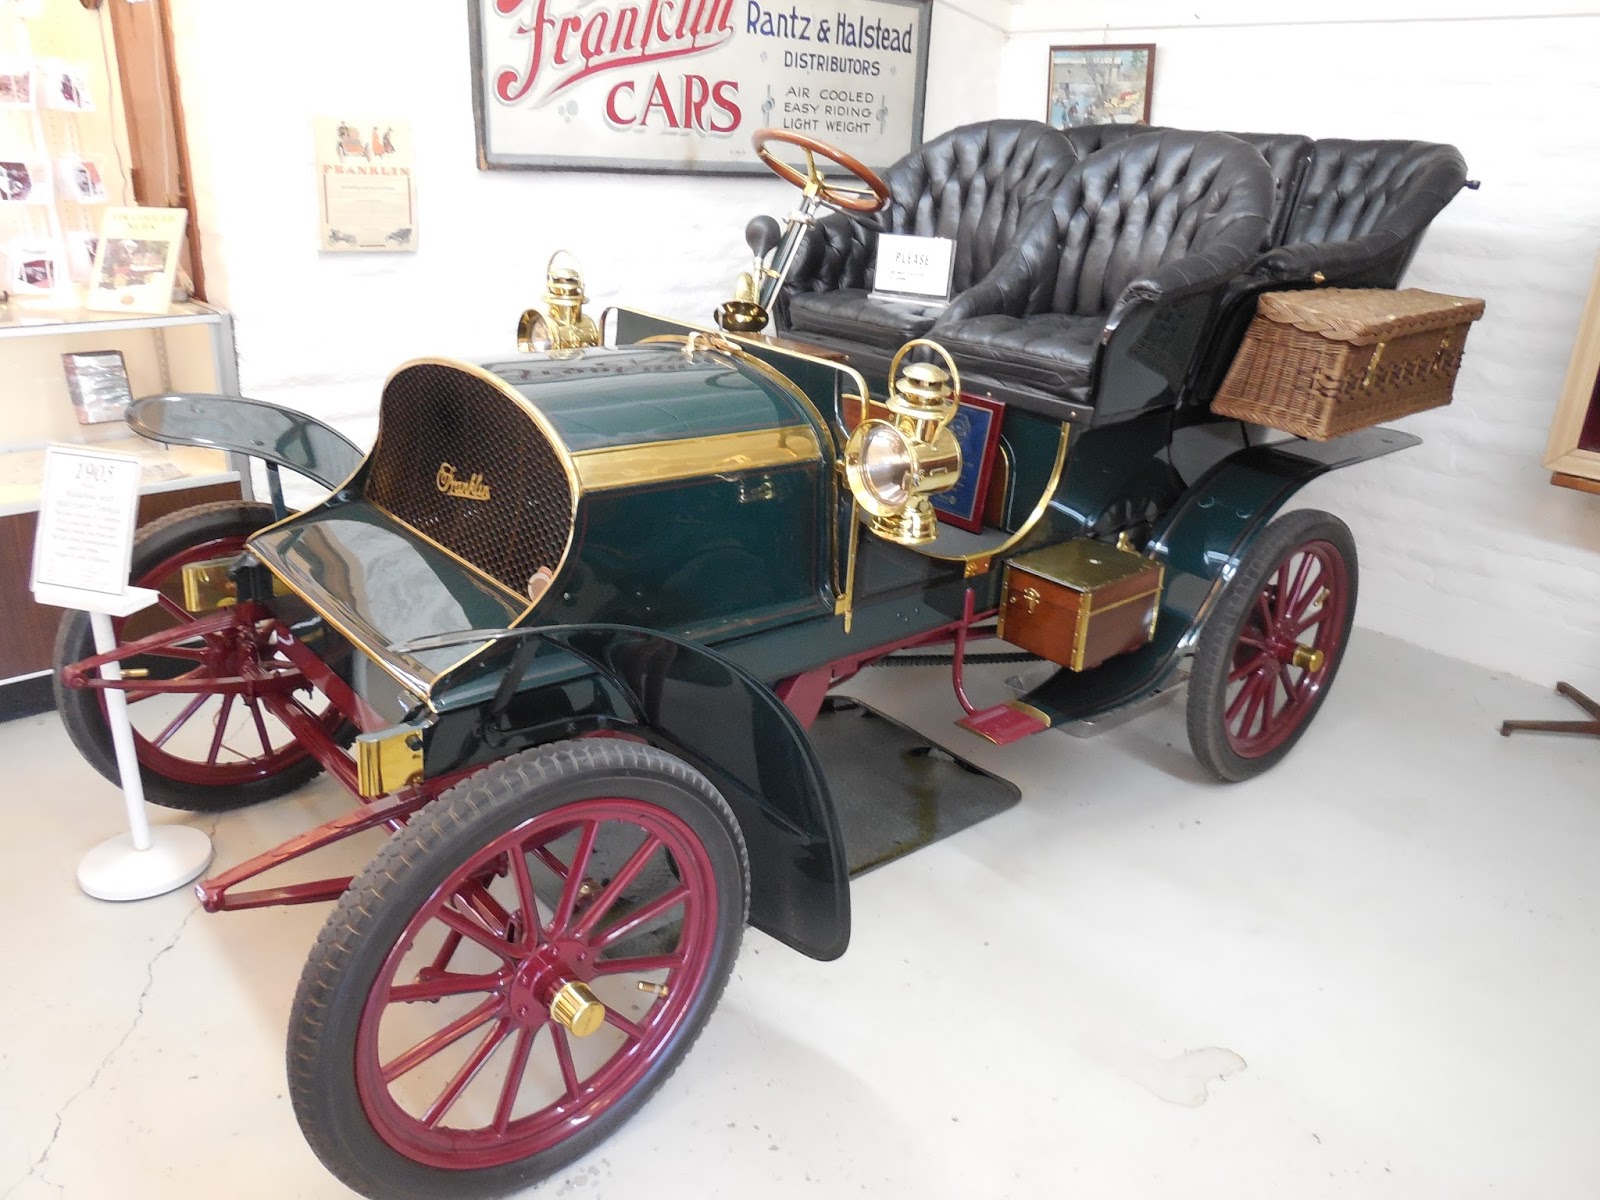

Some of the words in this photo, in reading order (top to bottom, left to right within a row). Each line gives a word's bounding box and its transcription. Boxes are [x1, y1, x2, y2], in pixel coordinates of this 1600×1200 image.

[746, 0, 812, 41] Rantz
[817, 19, 831, 44] &
[835, 12, 913, 54] Halstead
[493, 0, 734, 102] Franklin
[784, 50, 881, 77] DISTRIBUTORS
[606, 71, 742, 133] CARS
[785, 86, 811, 99] AIR
[819, 88, 875, 104] COOLED
[784, 102, 820, 115] EASY
[824, 104, 874, 118] RIDING
[783, 117, 819, 131] LIGHT
[825, 119, 871, 134] WEIGHT
[322, 164, 411, 176] FRANKLIN
[895, 251, 929, 266] PLEASE
[75, 462, 117, 483] 1905
